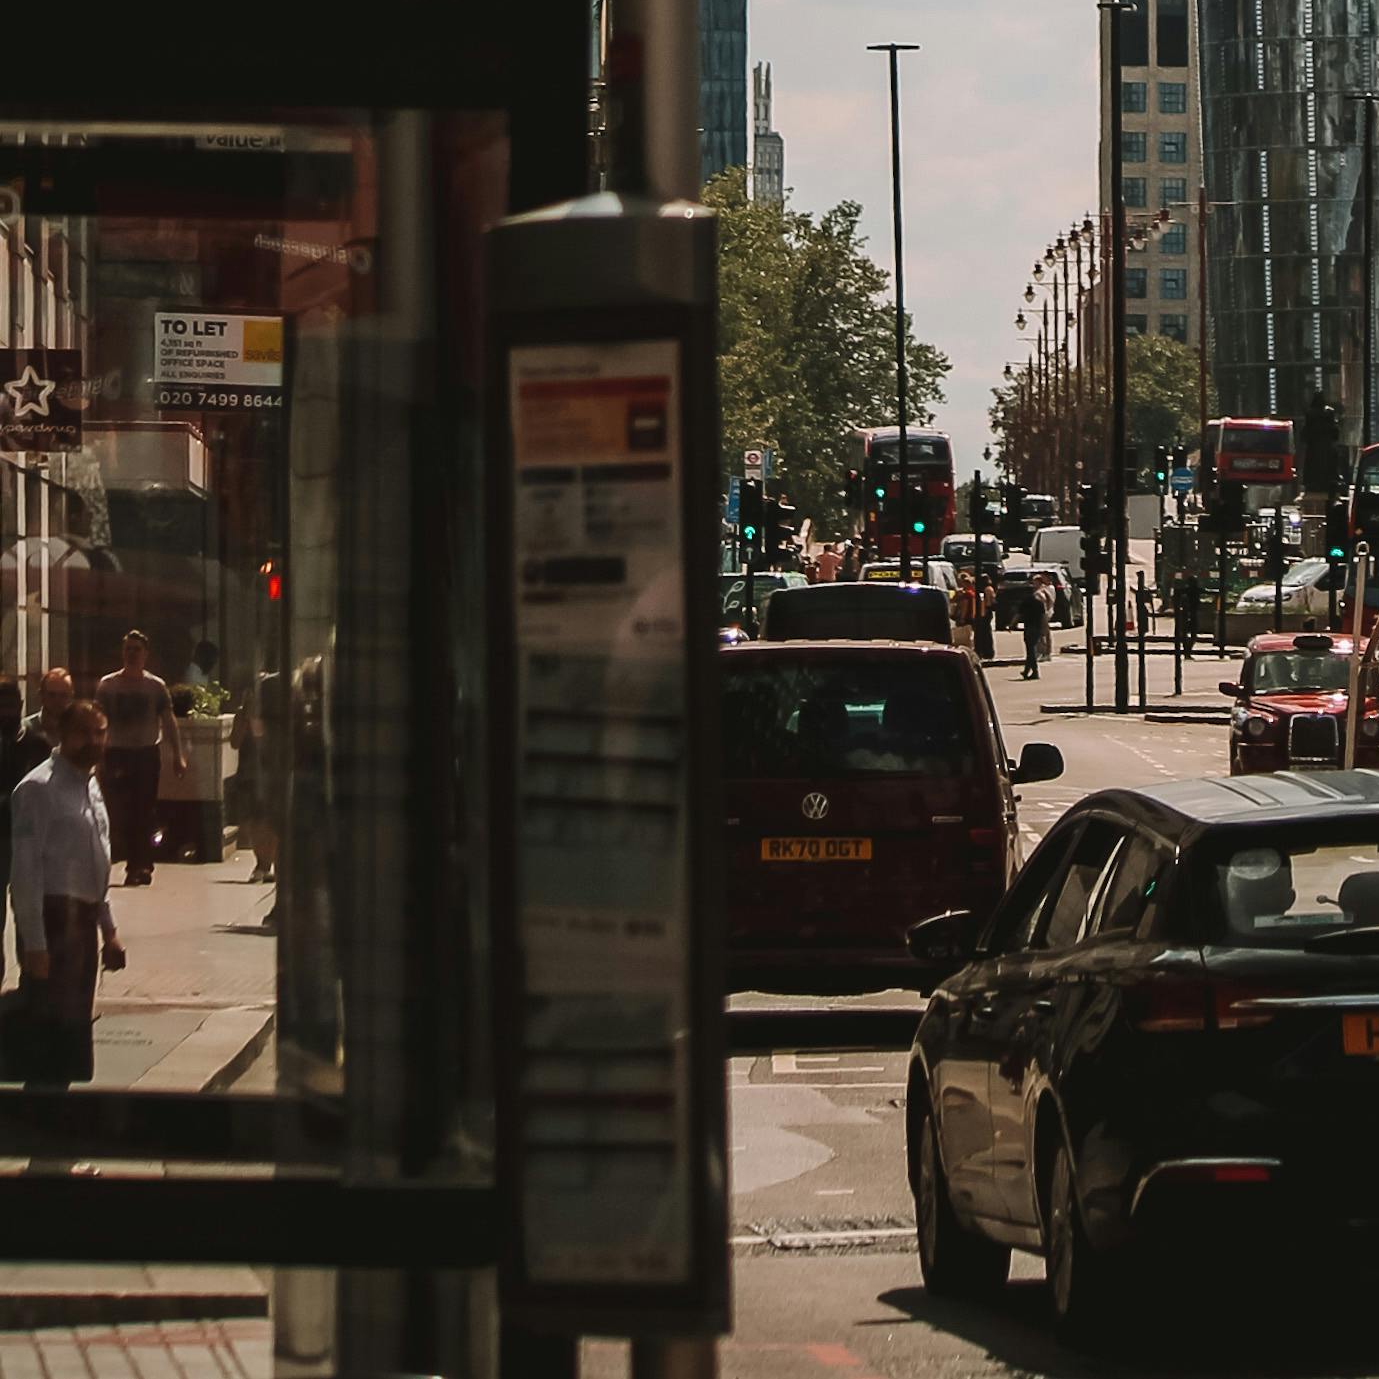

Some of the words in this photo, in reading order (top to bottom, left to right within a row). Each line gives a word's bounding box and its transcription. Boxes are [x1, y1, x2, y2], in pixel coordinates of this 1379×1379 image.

[160, 319, 188, 335] TO
[193, 320, 228, 337] LET
[160, 348, 175, 357] OF
[176, 349, 239, 359] REFURBISHED
[160, 358, 193, 367] OFFICE
[196, 359, 225, 368] SPACE
[160, 390, 192, 405] 020
[198, 392, 239, 407] 7499
[243, 393, 283, 408] 8644
[769, 839, 820, 859] RK70
